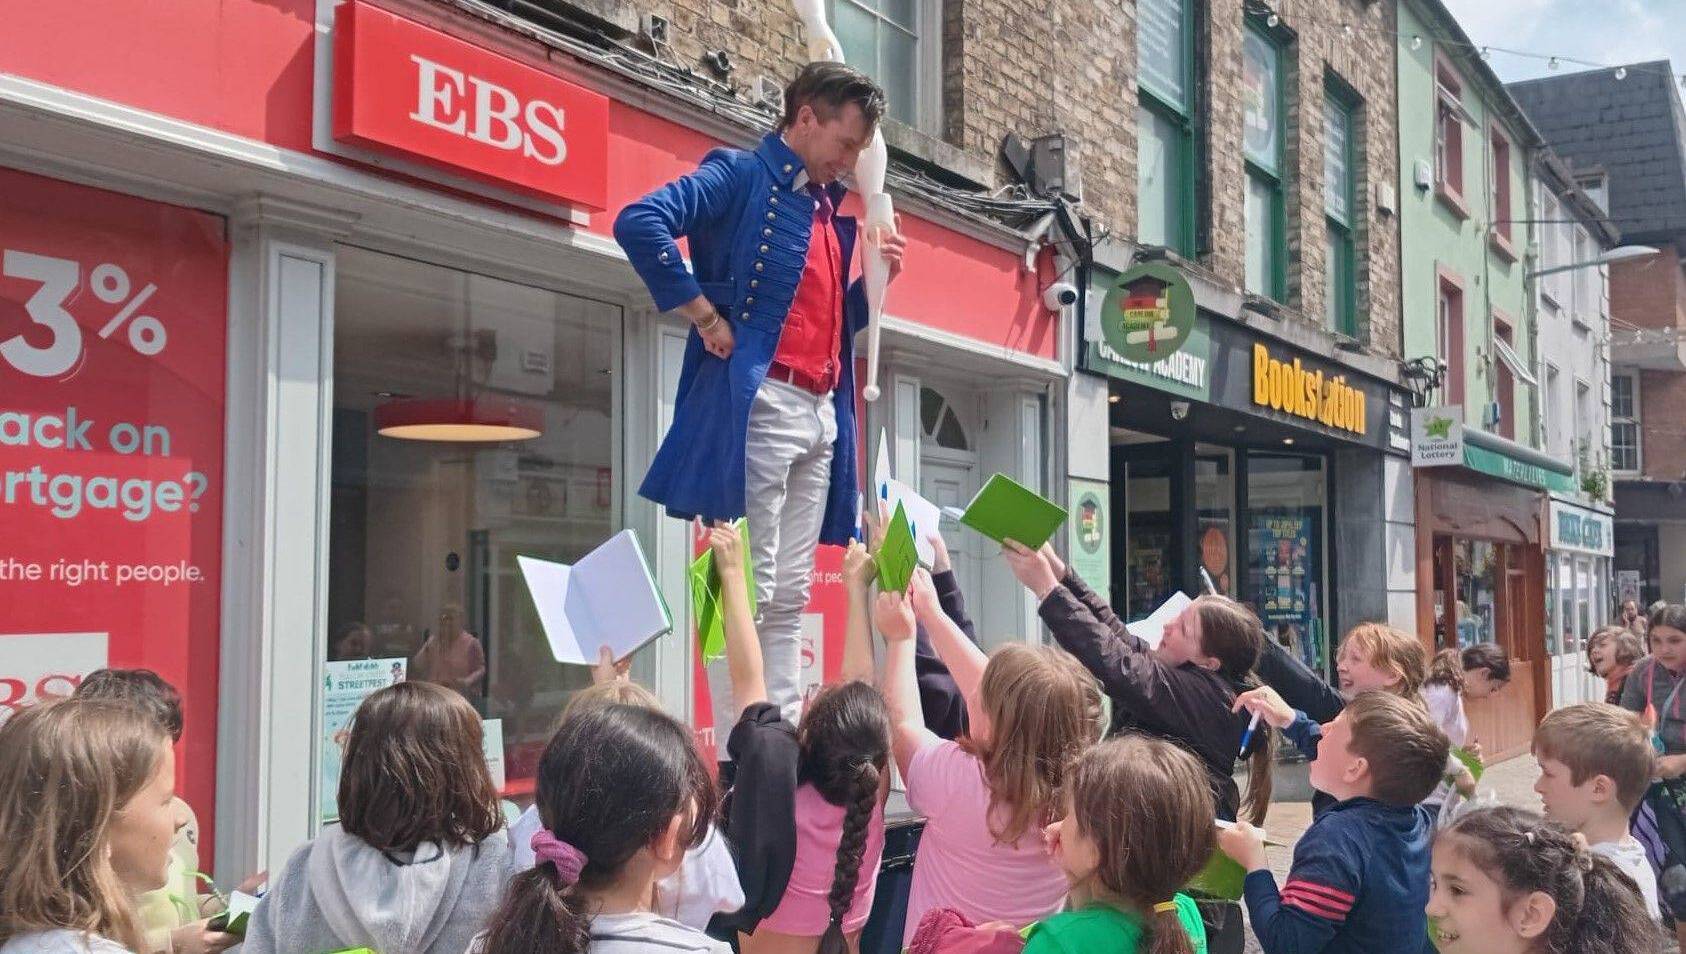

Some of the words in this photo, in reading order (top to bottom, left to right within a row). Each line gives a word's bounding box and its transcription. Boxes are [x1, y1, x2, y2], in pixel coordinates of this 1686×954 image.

[409, 54, 567, 165] EBS
[0, 250, 168, 377] 3%
[1254, 342, 1366, 434] Bookstation
[109, 422, 171, 457] on
[1418, 442, 1458, 451] National
[1421, 451, 1456, 460] Lottery
[0, 465, 208, 521] rtgage?
[0, 557, 42, 580] the
[50, 559, 109, 586] right
[116, 560, 205, 586] people.
